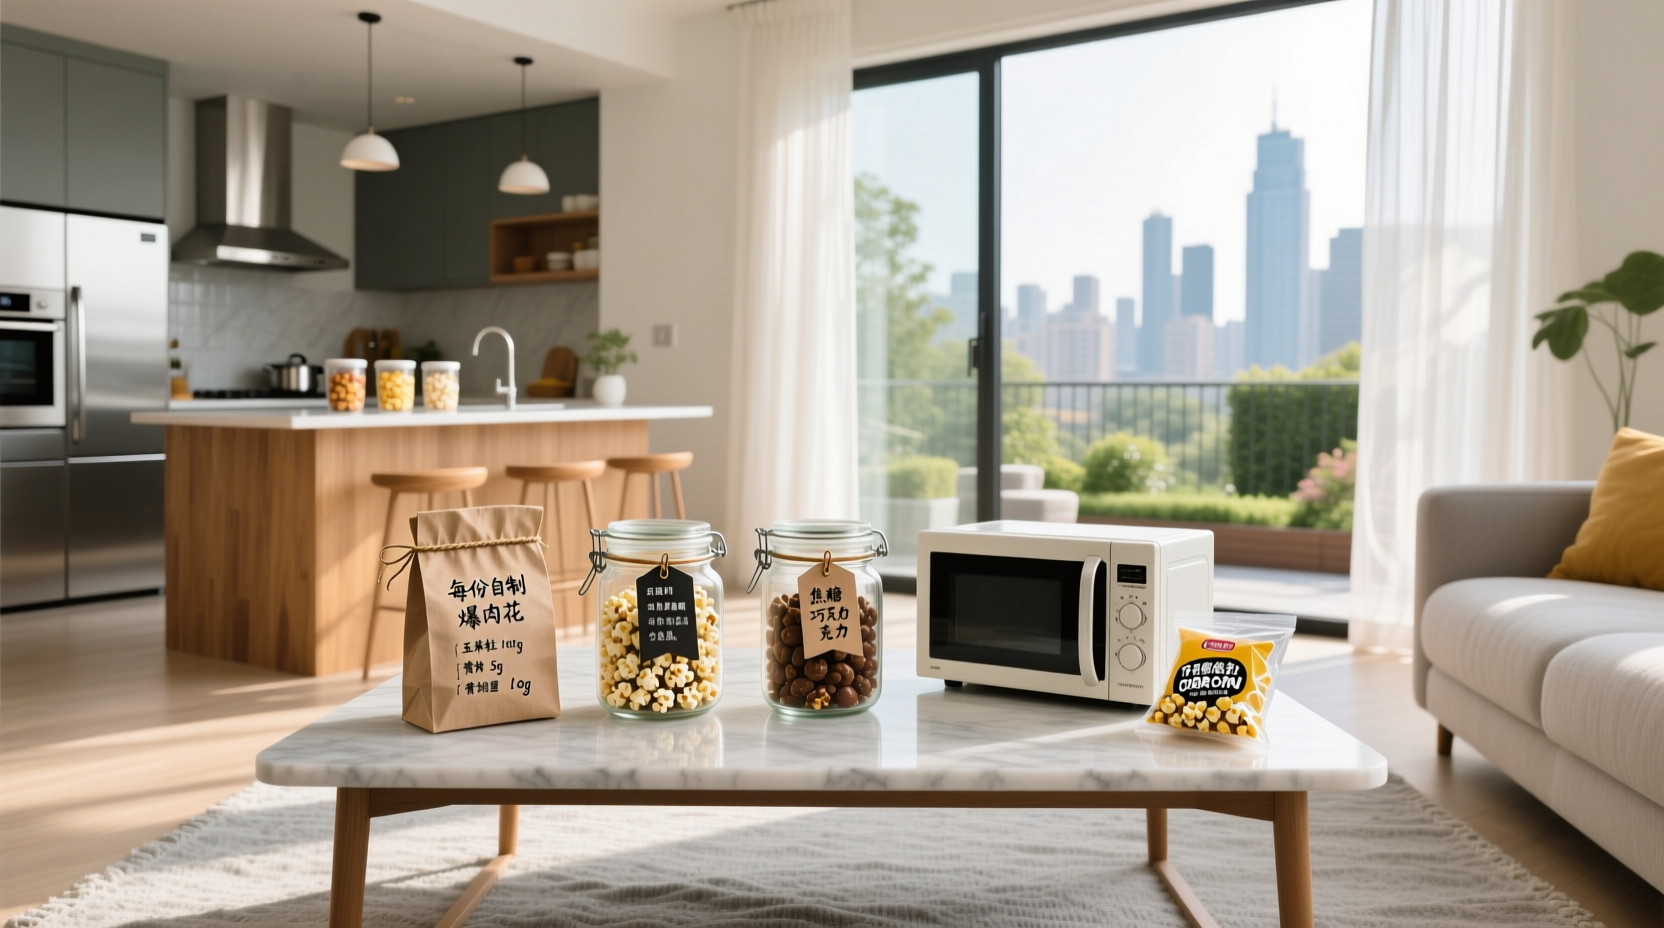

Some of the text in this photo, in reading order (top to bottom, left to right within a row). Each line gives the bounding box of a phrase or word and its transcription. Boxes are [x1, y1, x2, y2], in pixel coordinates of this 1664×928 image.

[448, 574, 526, 602] 每份自制
[810, 585, 842, 605] 焦糖
[819, 623, 848, 641] 克力
[490, 660, 503, 675] 5g
